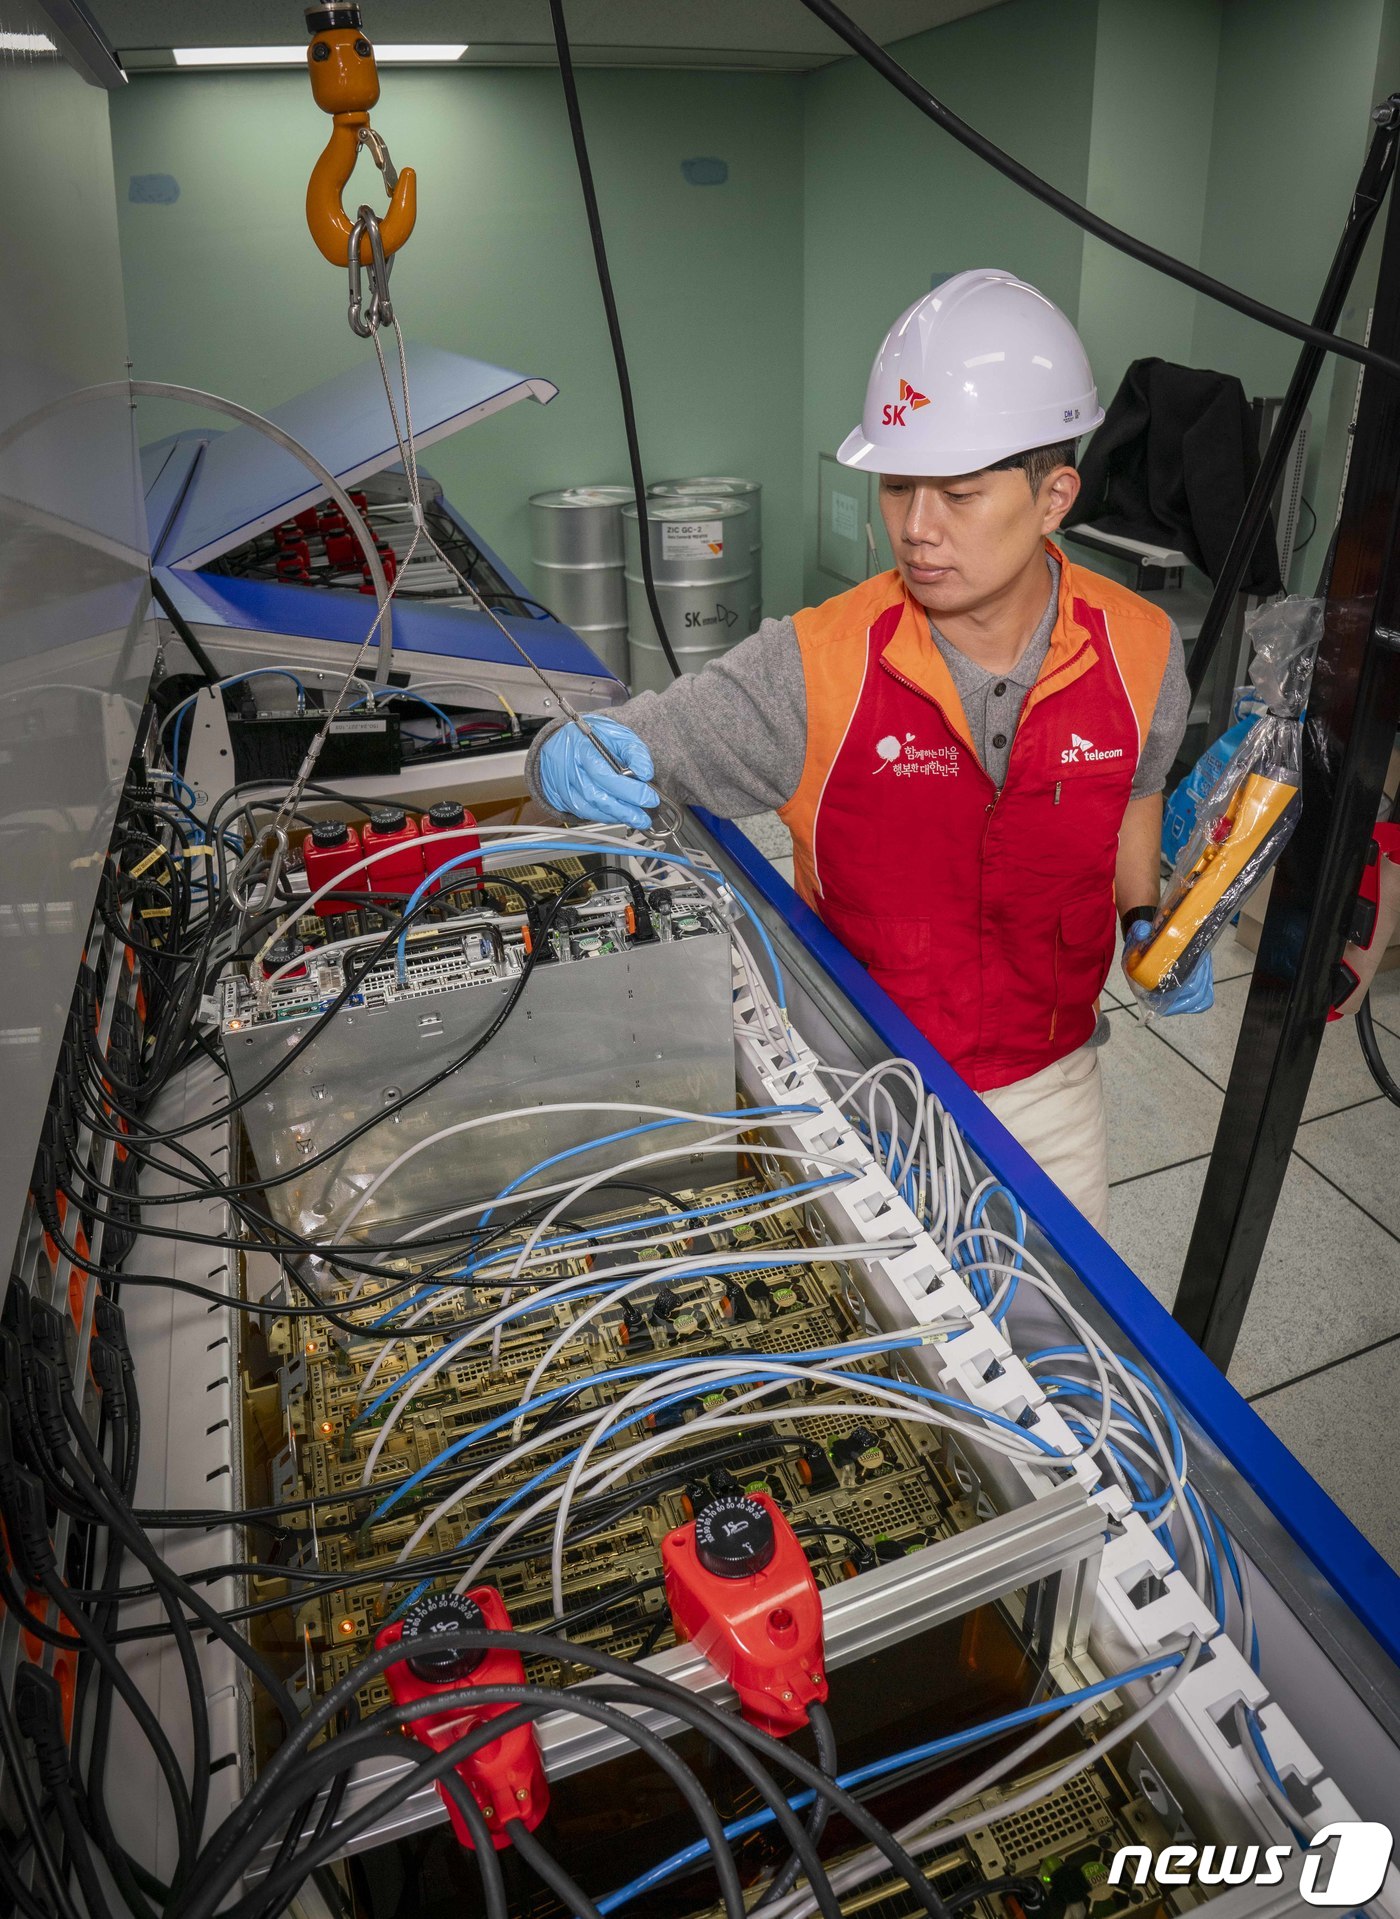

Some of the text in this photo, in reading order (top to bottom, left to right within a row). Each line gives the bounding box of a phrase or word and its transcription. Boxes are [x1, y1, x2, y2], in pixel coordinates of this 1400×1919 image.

[881, 404, 907, 427] SK
[685, 611, 701, 628] SK
[904, 745, 960, 761] 함께하는 마음
[1061, 748, 1123, 764] SK telecom
[892, 760, 960, 778] 행복한 대한민국
[708, 1510, 717, 1518] 70
[716, 1505, 725, 1513] 60
[704, 1517, 712, 1525] 80
[703, 1526, 711, 1534] 90
[413, 1618, 421, 1627] 80
[419, 1609, 428, 1618] 70
[428, 1603, 437, 1611] 60
[458, 1604, 467, 1612] 30
[464, 1611, 473, 1619] 20
